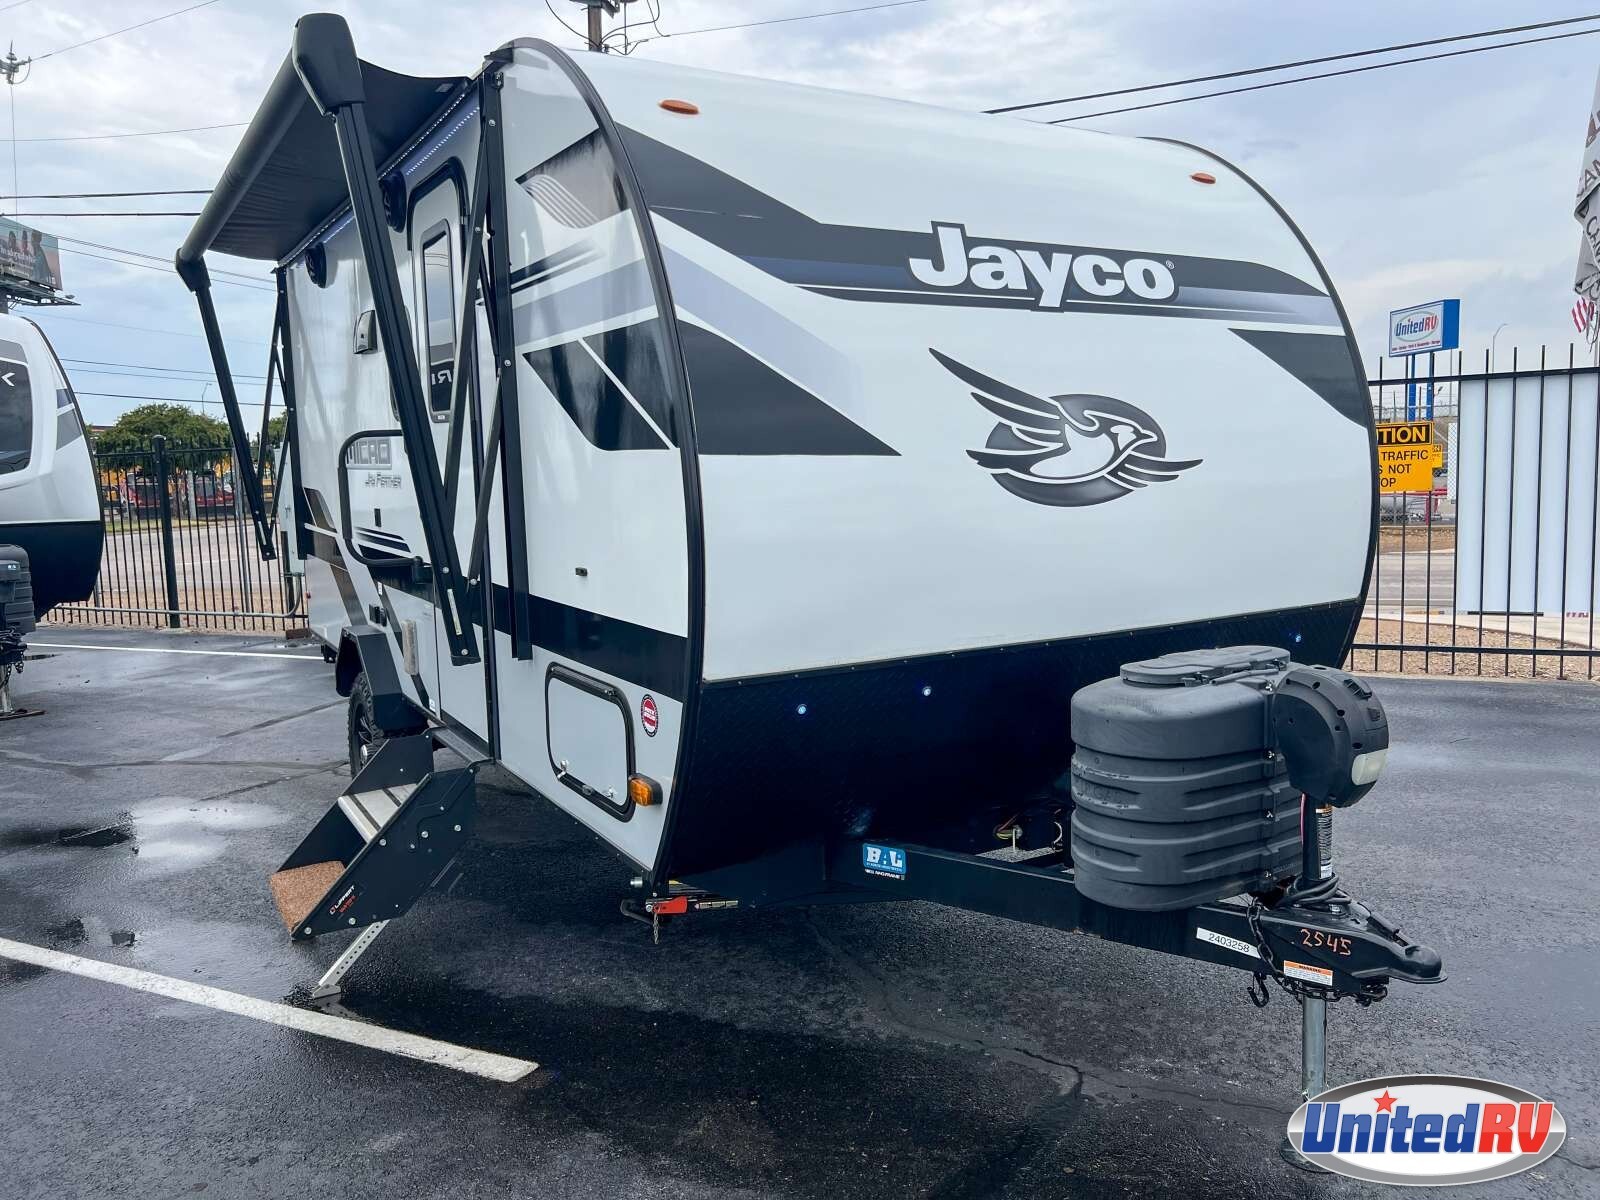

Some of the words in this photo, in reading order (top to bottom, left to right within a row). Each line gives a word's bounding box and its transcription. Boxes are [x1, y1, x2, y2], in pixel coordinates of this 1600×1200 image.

[909, 226, 1175, 308] Jayco
[1395, 315, 1438, 336] UnitedRV
[1376, 426, 1426, 444] TION
[1381, 450, 1428, 461] TRAFFIC
[1388, 464, 1412, 474] NOT
[1379, 477, 1396, 487] OP
[1208, 933, 1250, 953] 2403258
[1300, 928, 1352, 956] 2545
